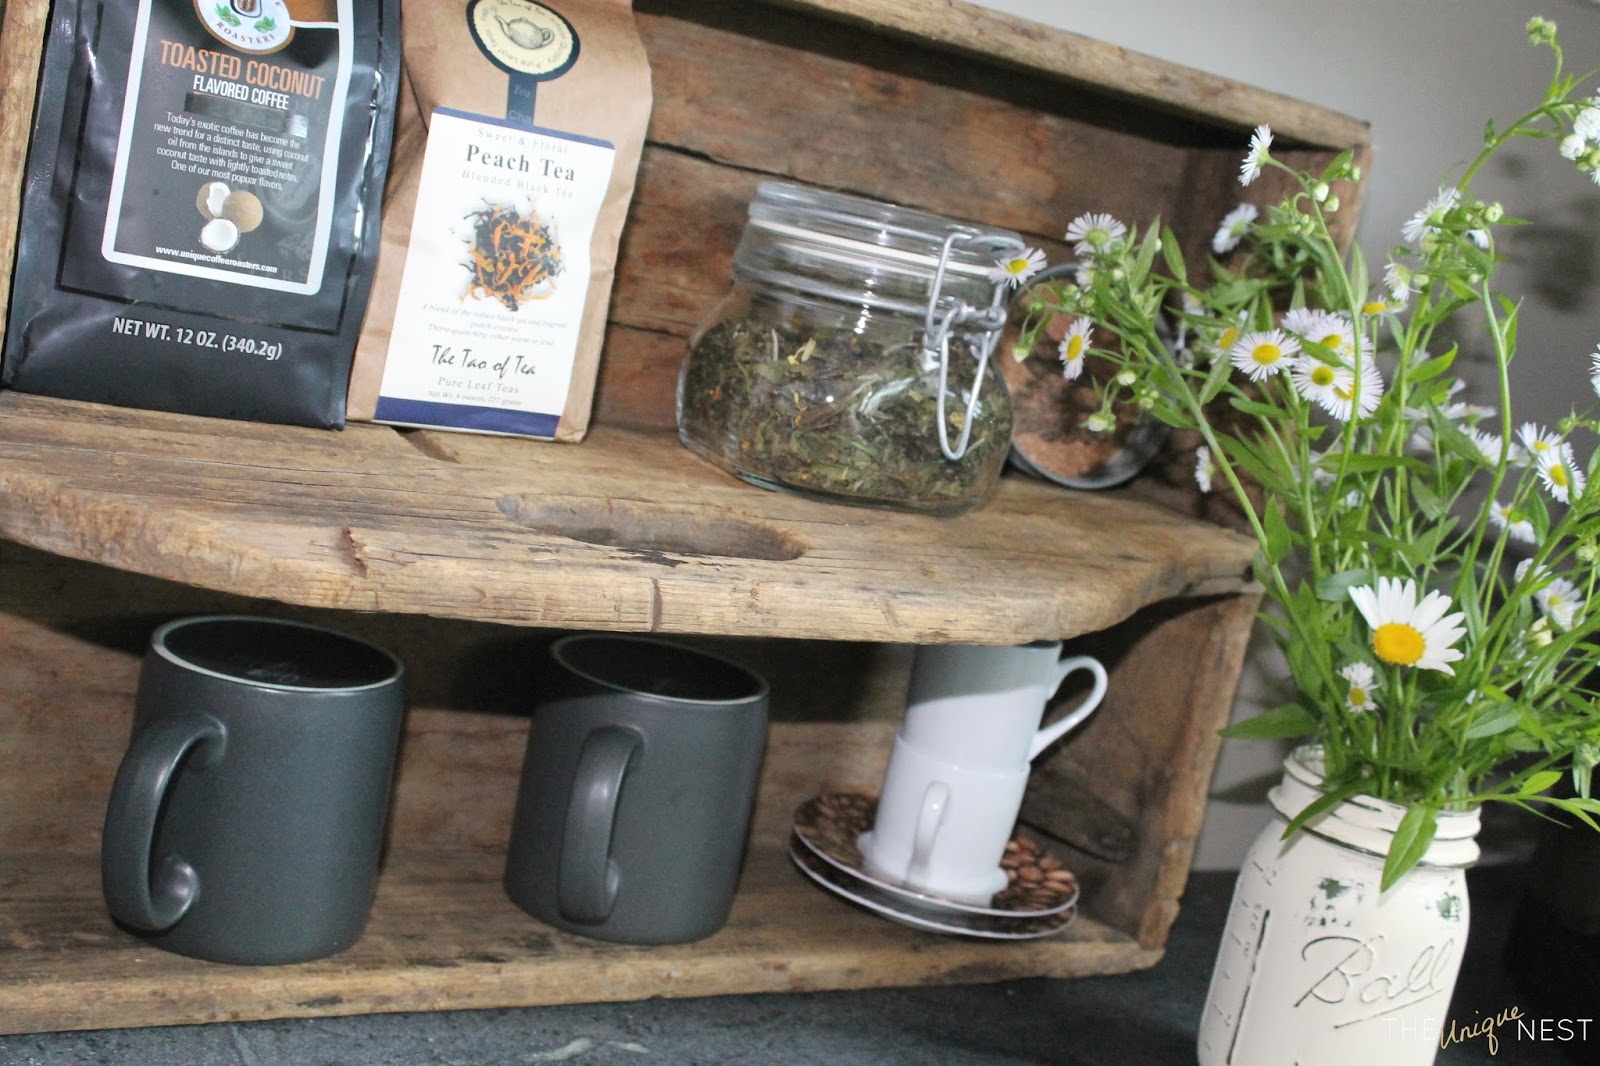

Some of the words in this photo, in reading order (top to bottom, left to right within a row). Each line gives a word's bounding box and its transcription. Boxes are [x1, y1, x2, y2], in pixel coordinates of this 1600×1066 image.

[216, 22, 275, 44] ROASTERS
[160, 39, 241, 80] TOASTED
[246, 60, 326, 100] COCONUT
[193, 75, 249, 100] FLAVORED
[251, 88, 289, 110] COFFEE
[154, 124, 171, 133] new
[173, 126, 193, 138] trend
[195, 130, 205, 140] for
[213, 134, 240, 147] distinct
[264, 145, 282, 158] using
[284, 150, 309, 162] coconut
[167, 112, 196, 127] Today's
[197, 122, 220, 131] exotic
[221, 126, 244, 136] coffee
[246, 129, 259, 140] has
[261, 132, 288, 146] become
[290, 138, 300, 149] the
[478, 128, 513, 144] Sweet
[519, 137, 525, 146] &
[533, 139, 568, 154] Floral
[157, 147, 187, 159] coconut
[189, 153, 207, 163] taste
[209, 157, 226, 167] with
[227, 159, 250, 174] lightly
[251, 165, 278, 178] toasted
[168, 137, 178, 146] oil
[179, 138, 197, 150] from
[199, 142, 211, 152] the
[212, 145, 238, 158] islands
[240, 152, 247, 160] to
[249, 153, 264, 164] give
[272, 160, 293, 170] sweet
[171, 160, 187, 171] One
[188, 164, 197, 173] of
[198, 167, 210, 176] our
[211, 170, 230, 180] most
[466, 143, 530, 173] Peach
[540, 158, 575, 182] Tea
[462, 169, 511, 187] Blended
[517, 179, 550, 194] Black
[556, 186, 573, 198] Tea
[155, 245, 278, 273] www.uniquecoffeeroasters.com
[112, 317, 143, 336] NET
[145, 323, 171, 341] WT.
[176, 328, 193, 345] 12
[196, 331, 219, 349] OZ.
[222, 335, 283, 361] (340.2g)
[432, 344, 454, 365] The
[462, 349, 486, 369] Tao
[493, 355, 511, 379] of
[515, 355, 536, 375] Tea
[438, 376, 463, 388] Pure
[467, 380, 493, 390] Leaf
[496, 383, 519, 393] Teas
[1294, 936, 1454, 1008] Ball
